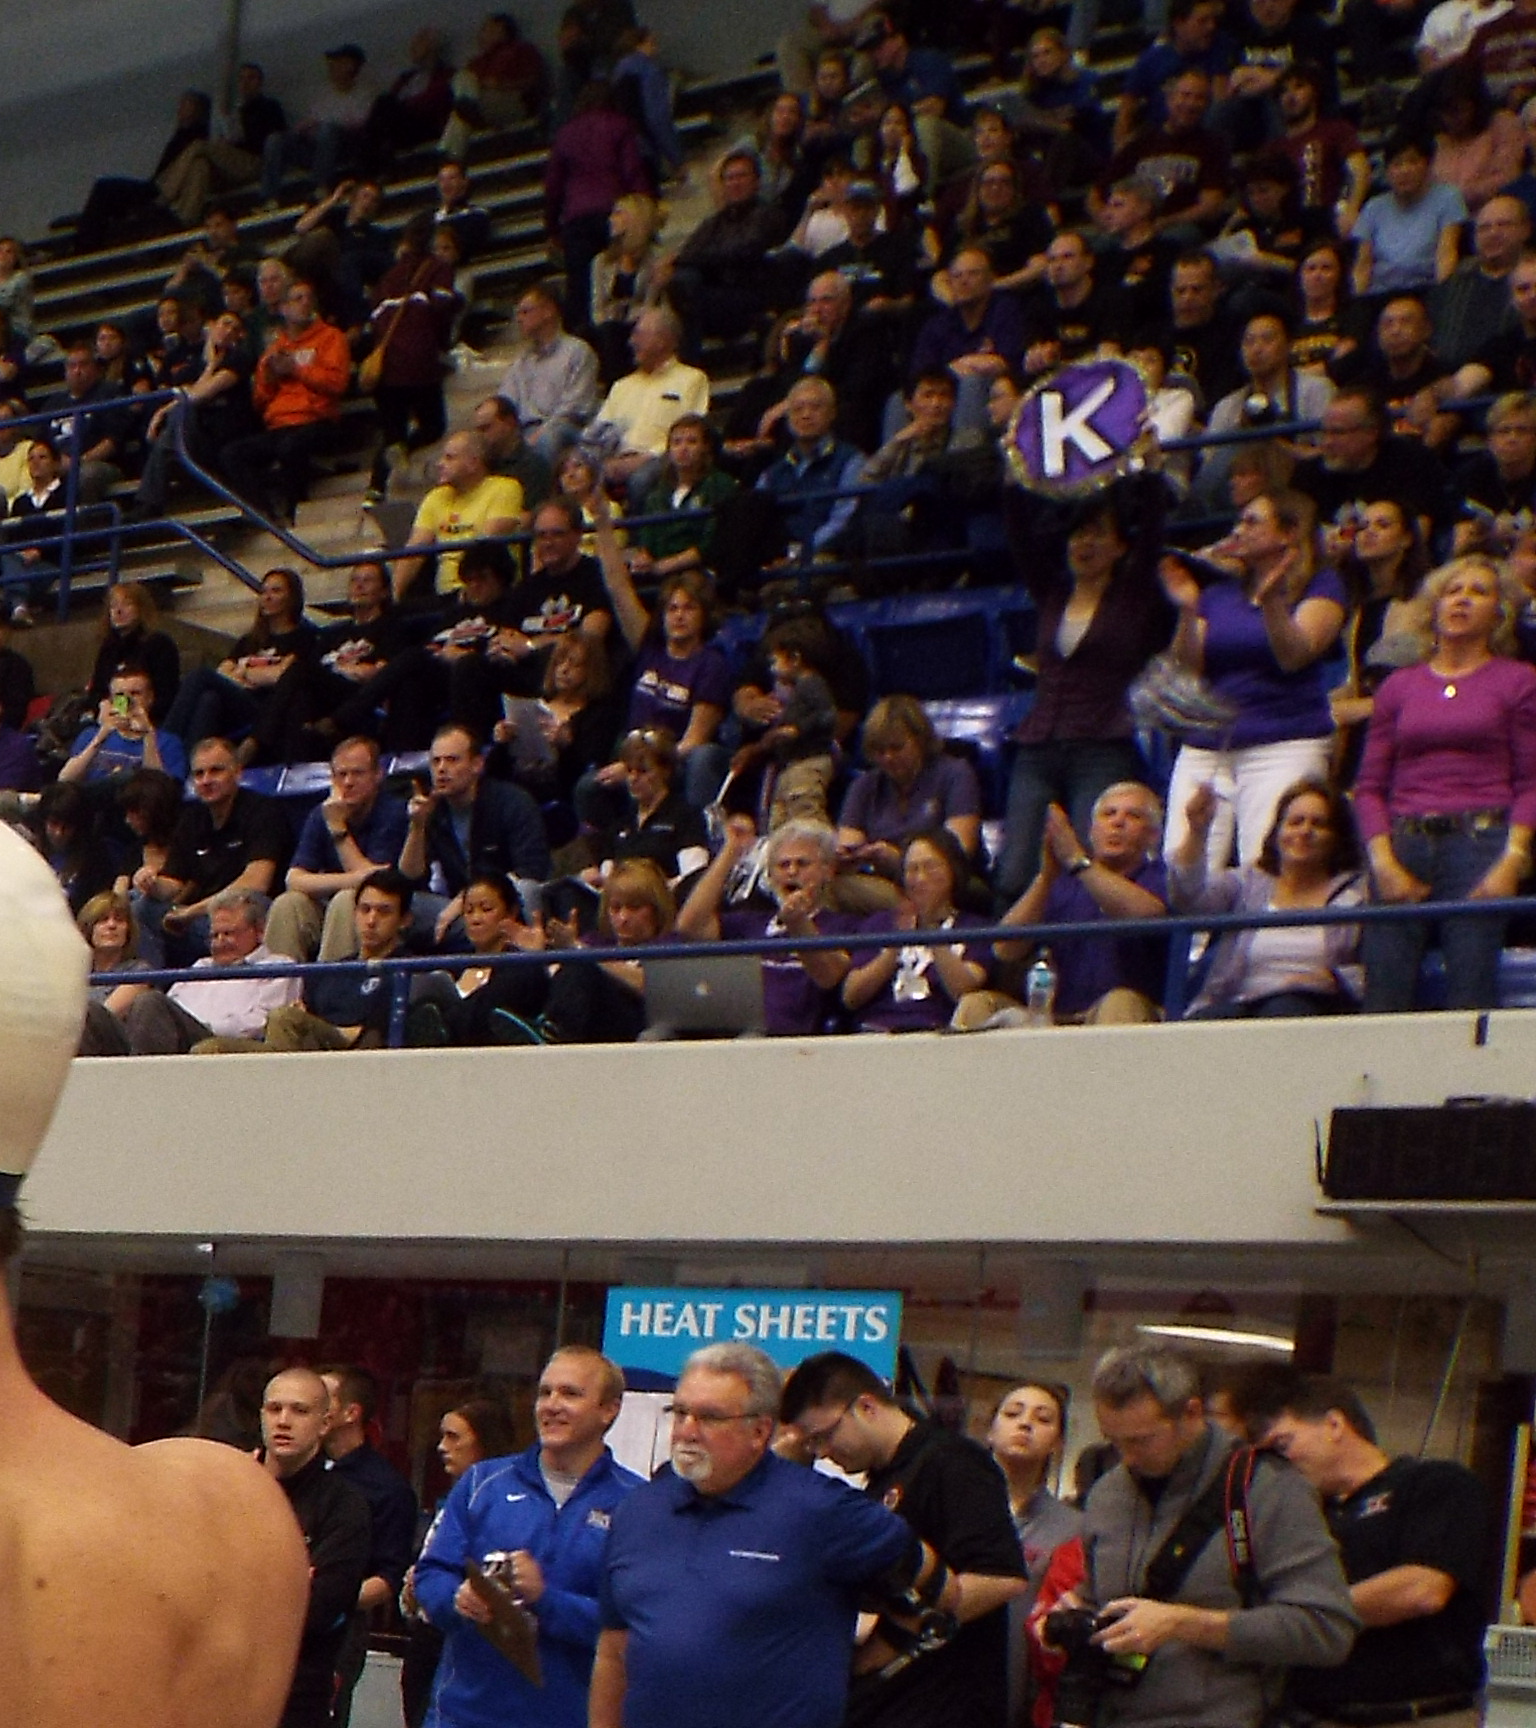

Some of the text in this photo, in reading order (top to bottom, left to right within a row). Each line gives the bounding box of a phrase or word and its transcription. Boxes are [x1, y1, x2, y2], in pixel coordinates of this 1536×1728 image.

[1039, 376, 1117, 478] K
[619, 1302, 889, 1342] HEAT SHEETS
